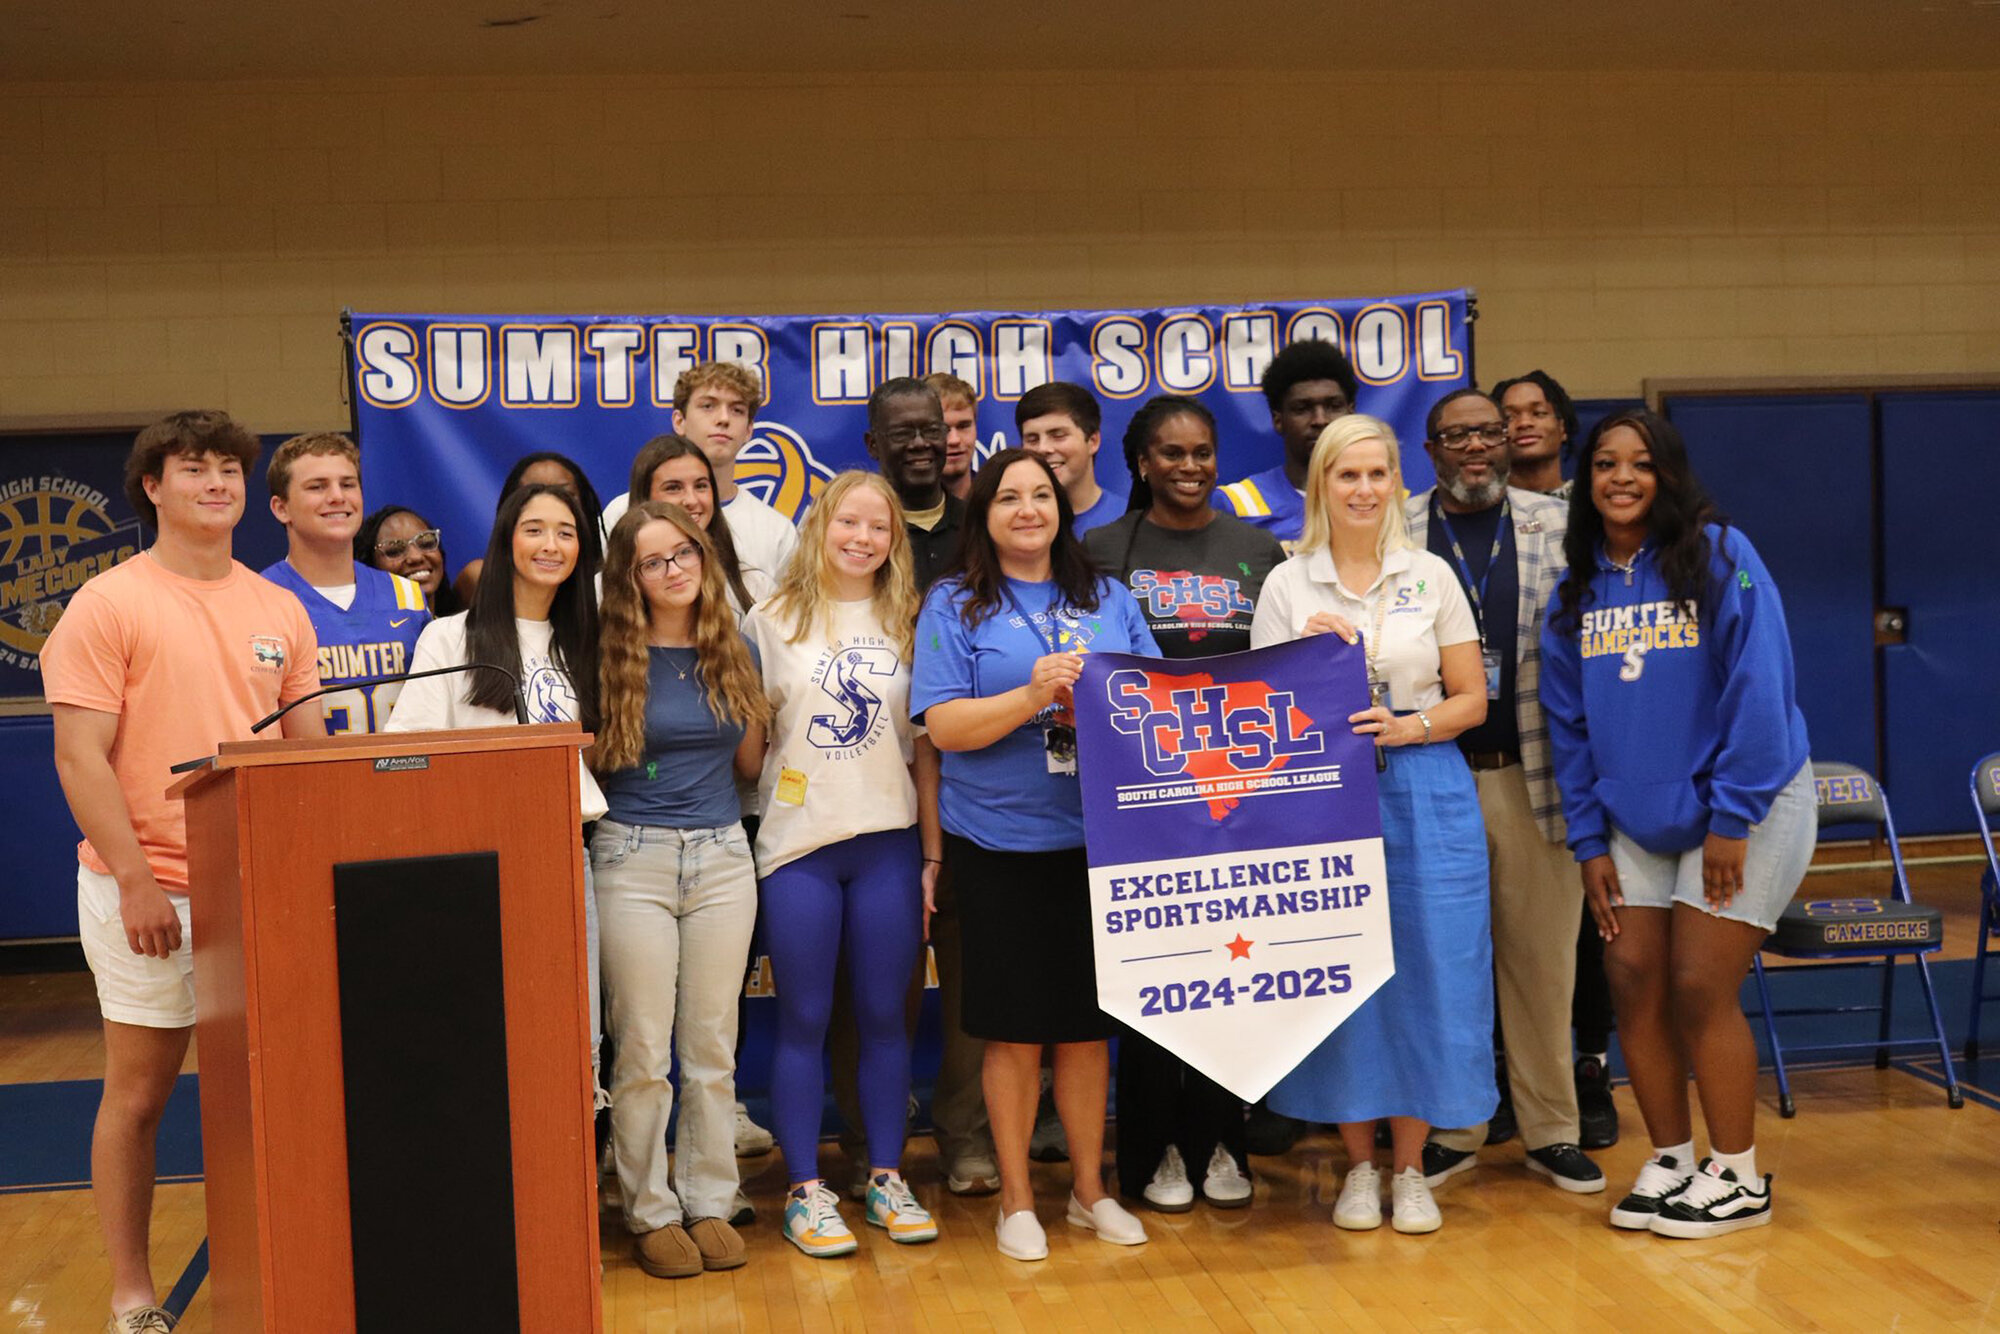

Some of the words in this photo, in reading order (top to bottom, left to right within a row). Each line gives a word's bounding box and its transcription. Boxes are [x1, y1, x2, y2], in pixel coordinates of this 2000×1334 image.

[811, 319, 1054, 405] HIGH
[0, 477, 34, 501] IGH
[40, 476, 110, 512] SCHOOL
[0, 546, 135, 609] MECOCK
[17, 546, 70, 576] LADY
[1130, 569, 1255, 618] SCHSL
[1581, 599, 1699, 636] SUMTER
[0, 648, 17, 665] 24
[318, 641, 406, 680] SUMTER
[853, 636, 885, 646] HIGH
[1581, 623, 1700, 659] GAMECOCKS
[1619, 642, 1648, 682] S
[825, 716, 889, 761] VOLLEYBALL
[1107, 669, 1325, 776] SCHSL
[1117, 789, 1157, 802] SOUTH
[1158, 783, 1214, 798] CAROLINA
[1216, 780, 1245, 793] HIGH
[1245, 775, 1292, 791] SCHOOL
[1292, 771, 1341, 787] LEAGUE
[1813, 776, 1873, 805] TER
[1110, 859, 1311, 901] EXCELLENCE
[1320, 854, 1354, 880] IN
[1106, 884, 1372, 934] SPORTSMANSHIP
[1824, 920, 1929, 943] GAMECOCKS
[1139, 964, 1353, 1017] 2024-2025
